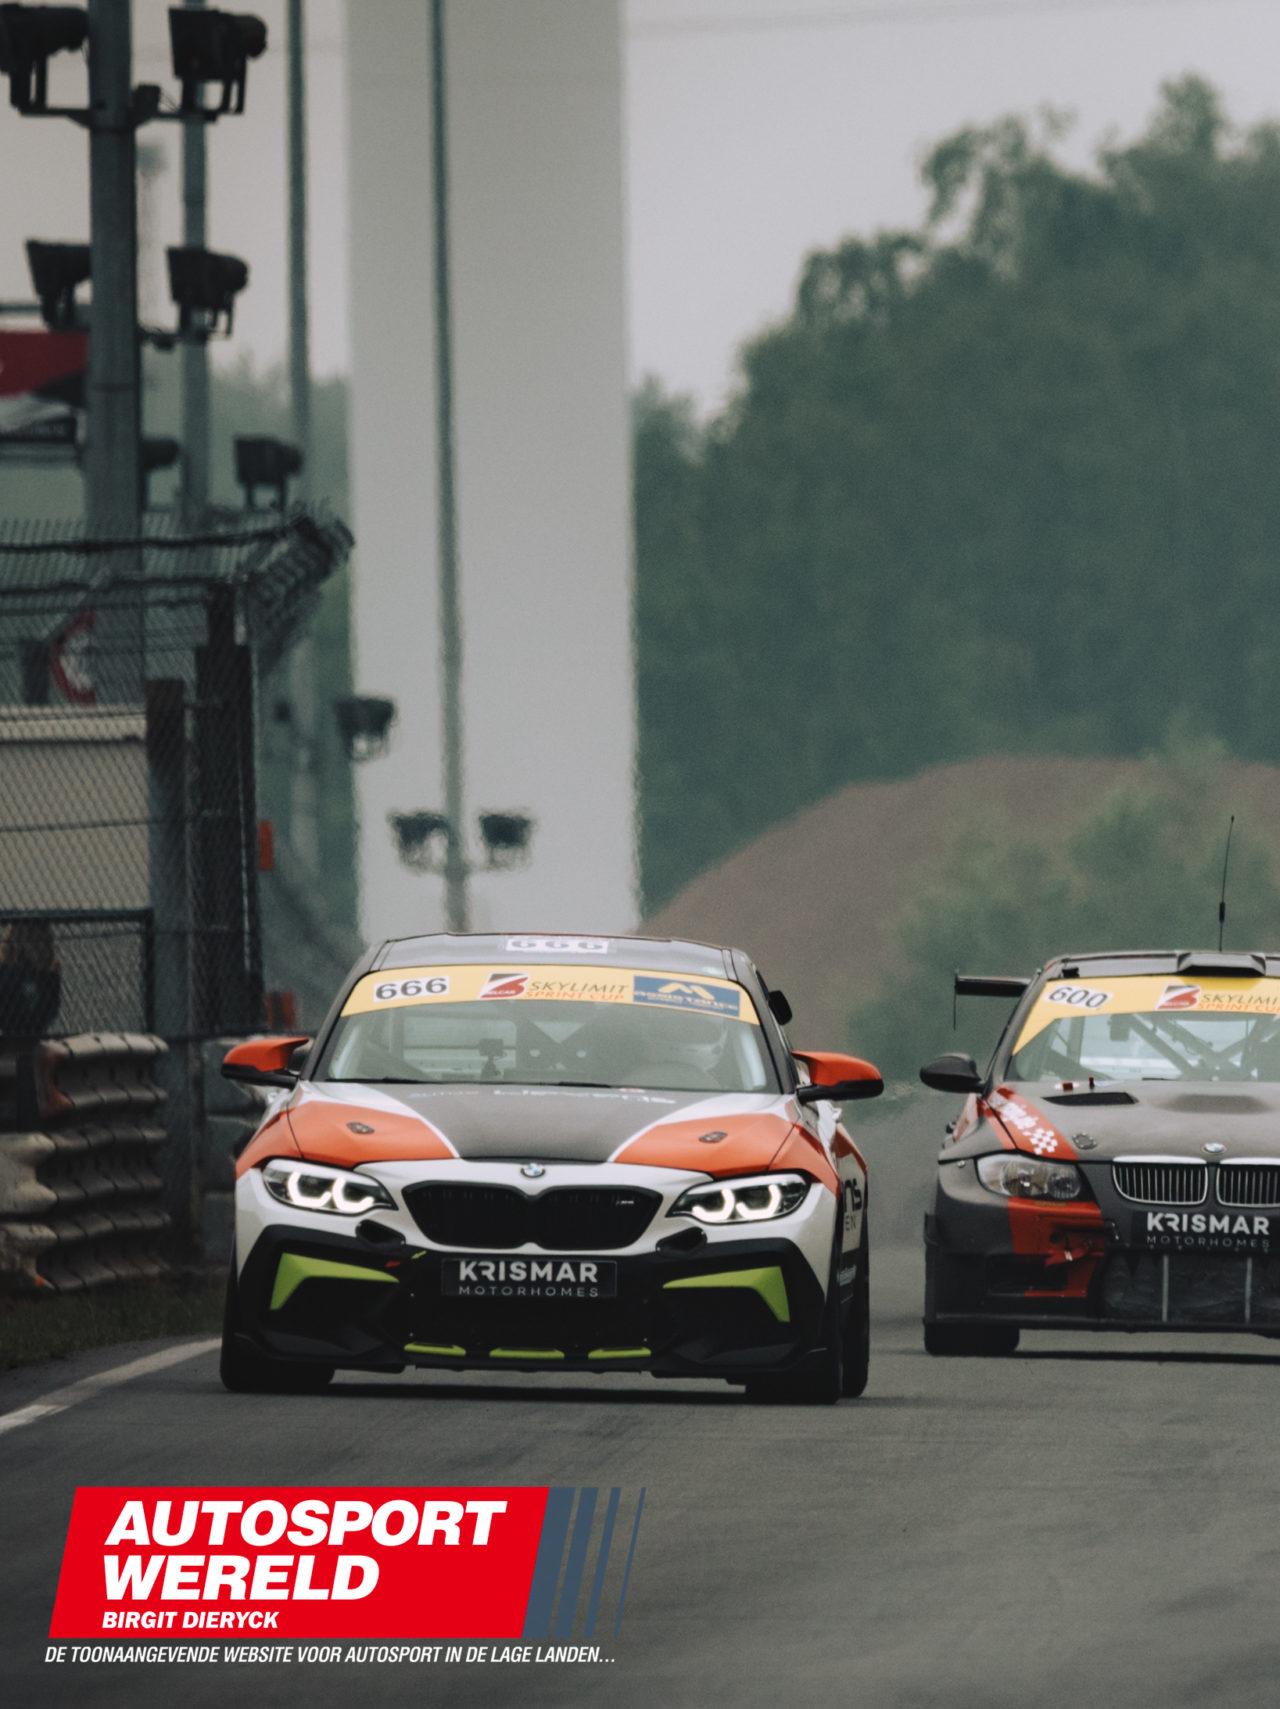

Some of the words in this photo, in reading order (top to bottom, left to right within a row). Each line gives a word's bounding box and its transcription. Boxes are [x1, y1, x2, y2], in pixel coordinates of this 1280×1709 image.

[375, 977, 448, 1000] 666
[531, 981, 628, 993] SKYLIMIT
[525, 991, 584, 1000] SPRINT
[589, 993, 625, 1001] CUP
[1049, 986, 1108, 1009] 600
[1199, 1002, 1250, 1011] SPRINT
[1146, 1211, 1270, 1236] KRISMAR
[1146, 1235, 1270, 1249] MOTORHOMES
[459, 1260, 599, 1283] KRISMAR
[458, 1285, 599, 1298] MOTORHOMES
